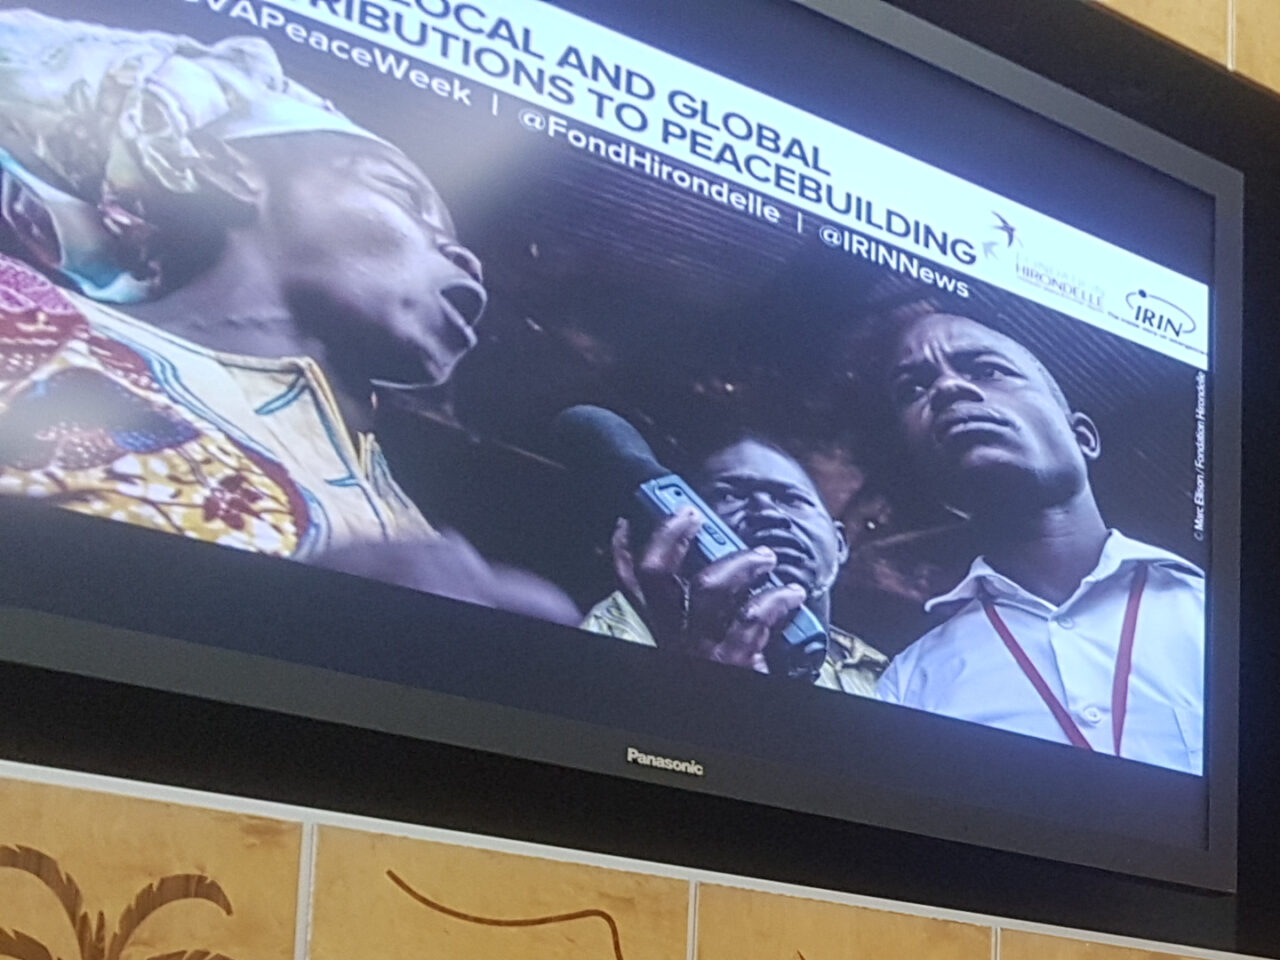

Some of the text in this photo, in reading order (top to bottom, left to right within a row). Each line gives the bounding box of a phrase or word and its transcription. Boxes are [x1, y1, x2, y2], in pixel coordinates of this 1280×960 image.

[392, 0, 831, 176] OCAL AND GLOBAL
[518, 108, 781, 223] @FondHirondelle
[819, 225, 969, 298] @IRINNews
[587, 88, 649, 133] TO
[661, 118, 976, 265] PEACEBUILDING
[1134, 305, 1183, 337] IRIN
[627, 747, 703, 775] Panasonic
